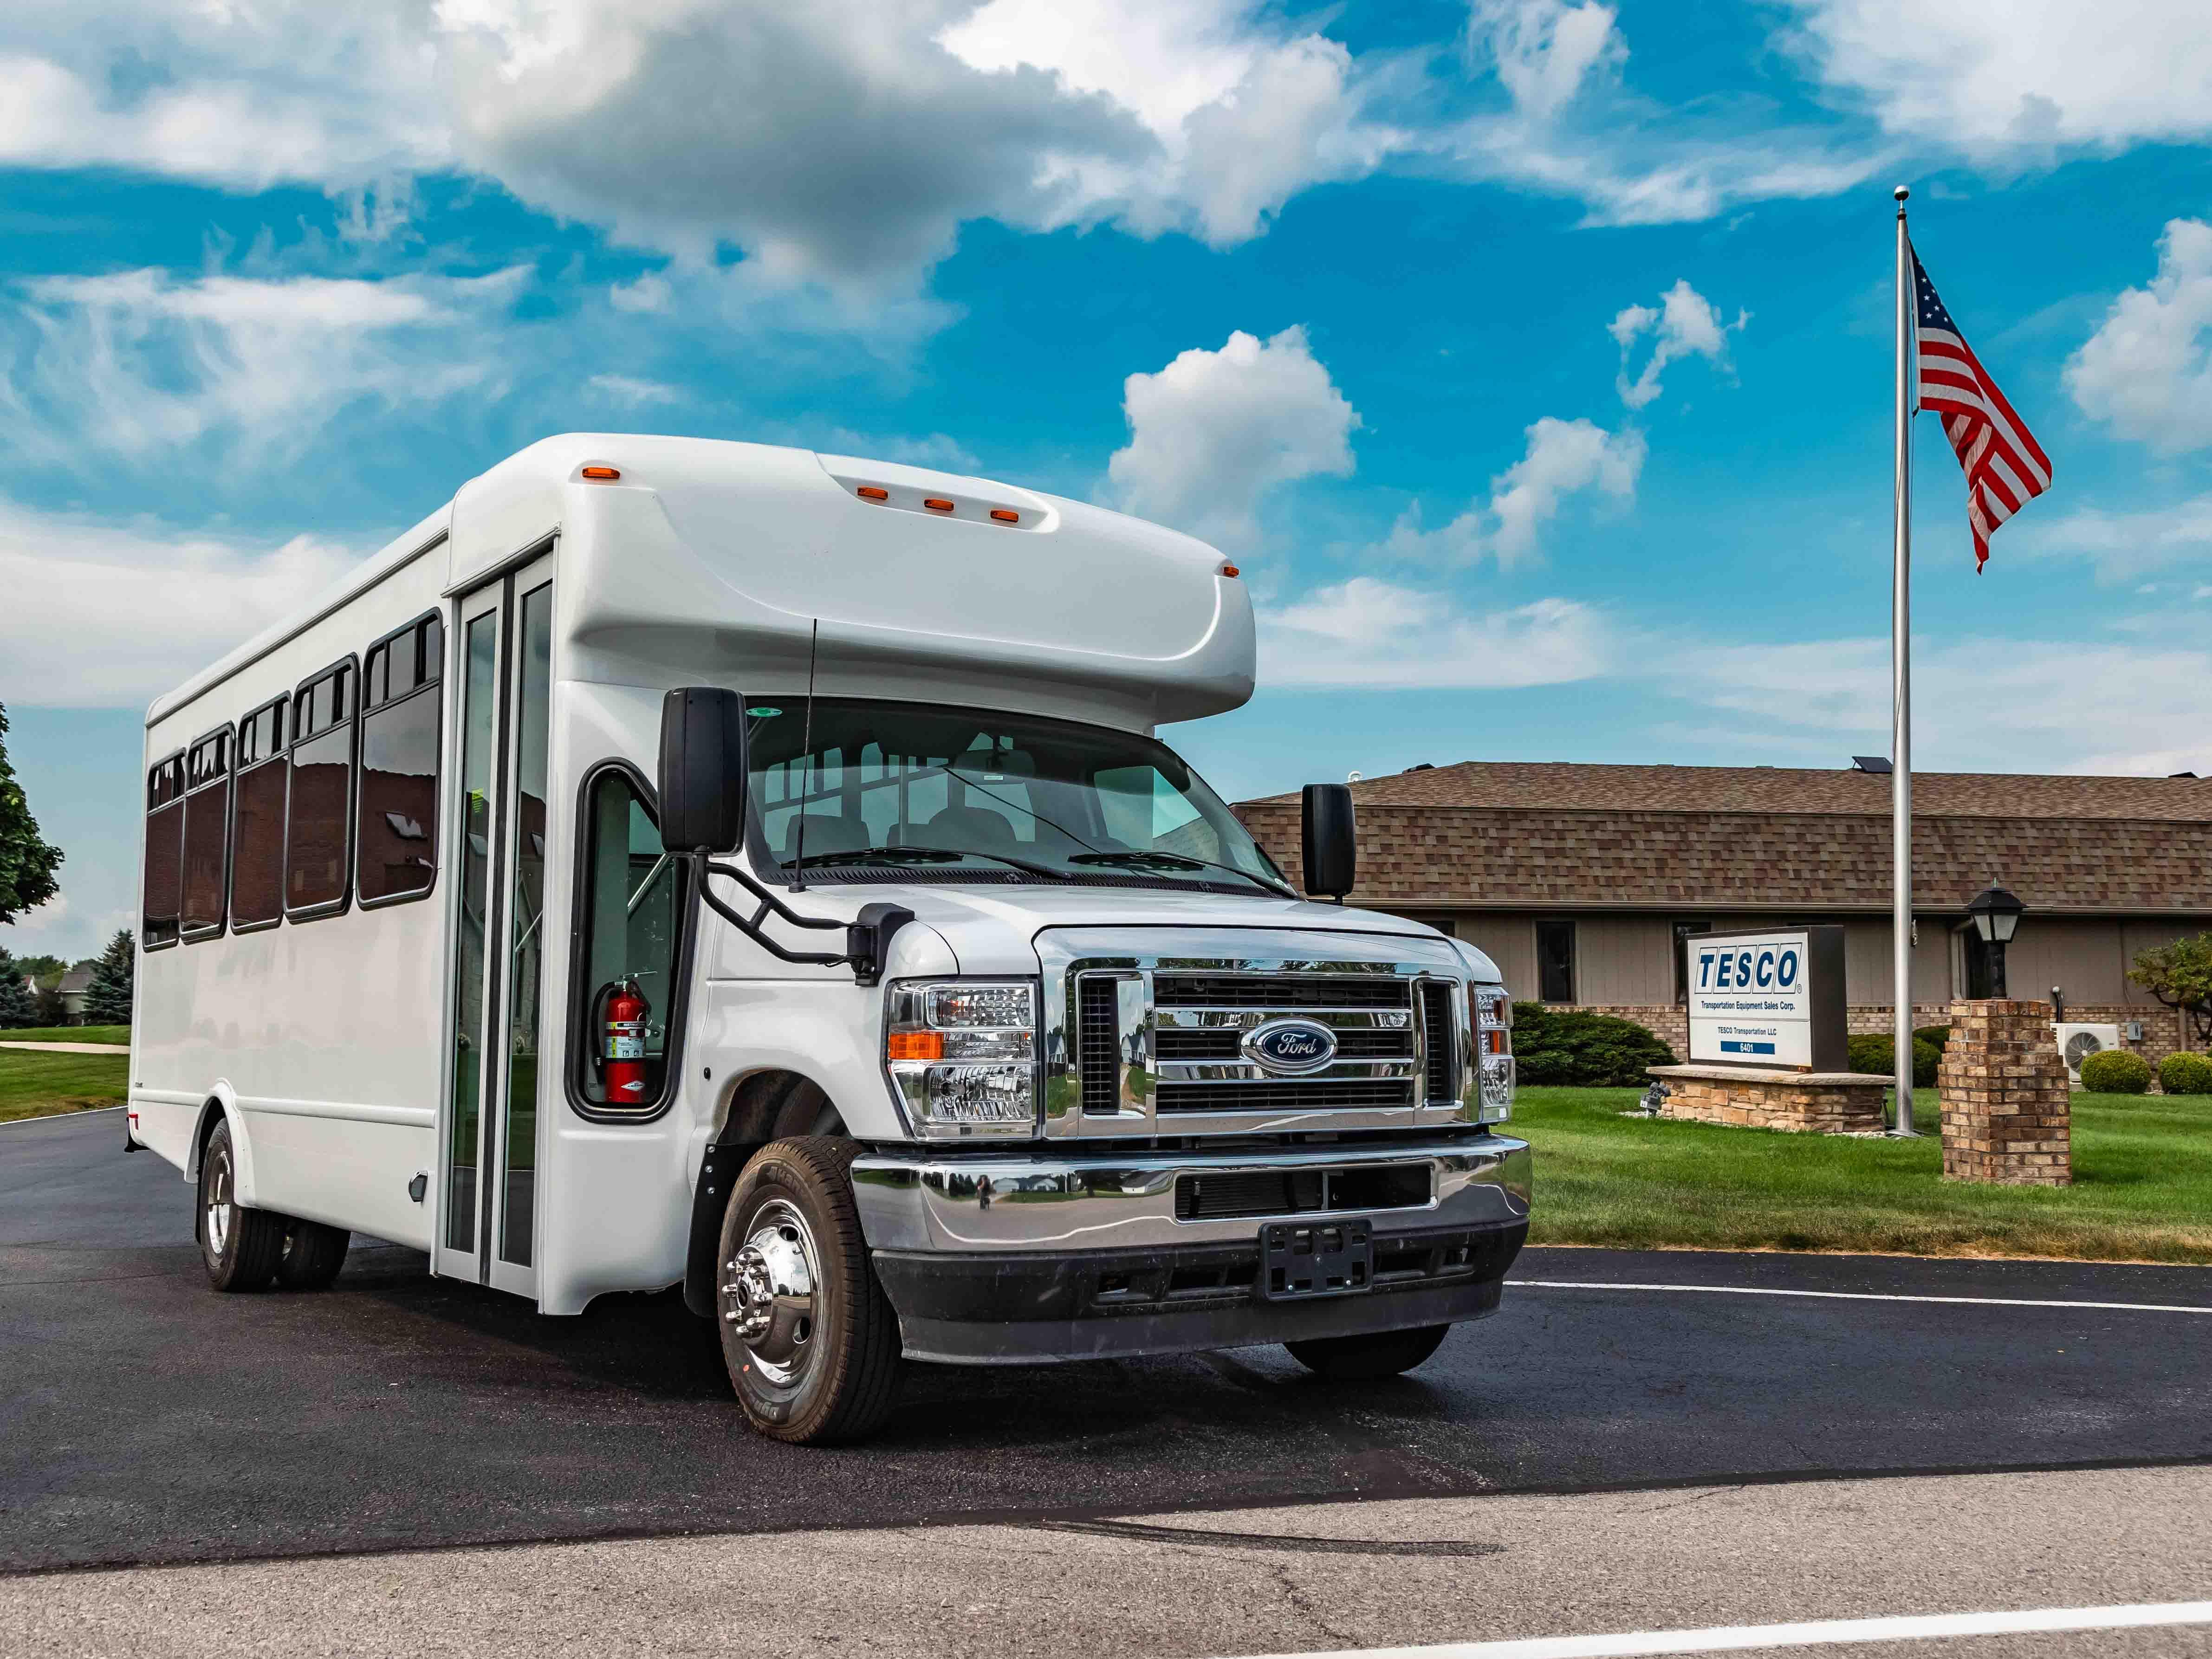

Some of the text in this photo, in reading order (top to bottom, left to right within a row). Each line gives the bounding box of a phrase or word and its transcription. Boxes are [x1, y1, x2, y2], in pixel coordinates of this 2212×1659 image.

[1700, 950, 1797, 987] TESCO
[1701, 1001, 1796, 1011] Transportation Equipment Sales Corp.
[1734, 1027, 1766, 1035] Transportation
[1278, 1033, 1317, 1054] Ford
[1740, 1043, 1753, 1052] 6401
